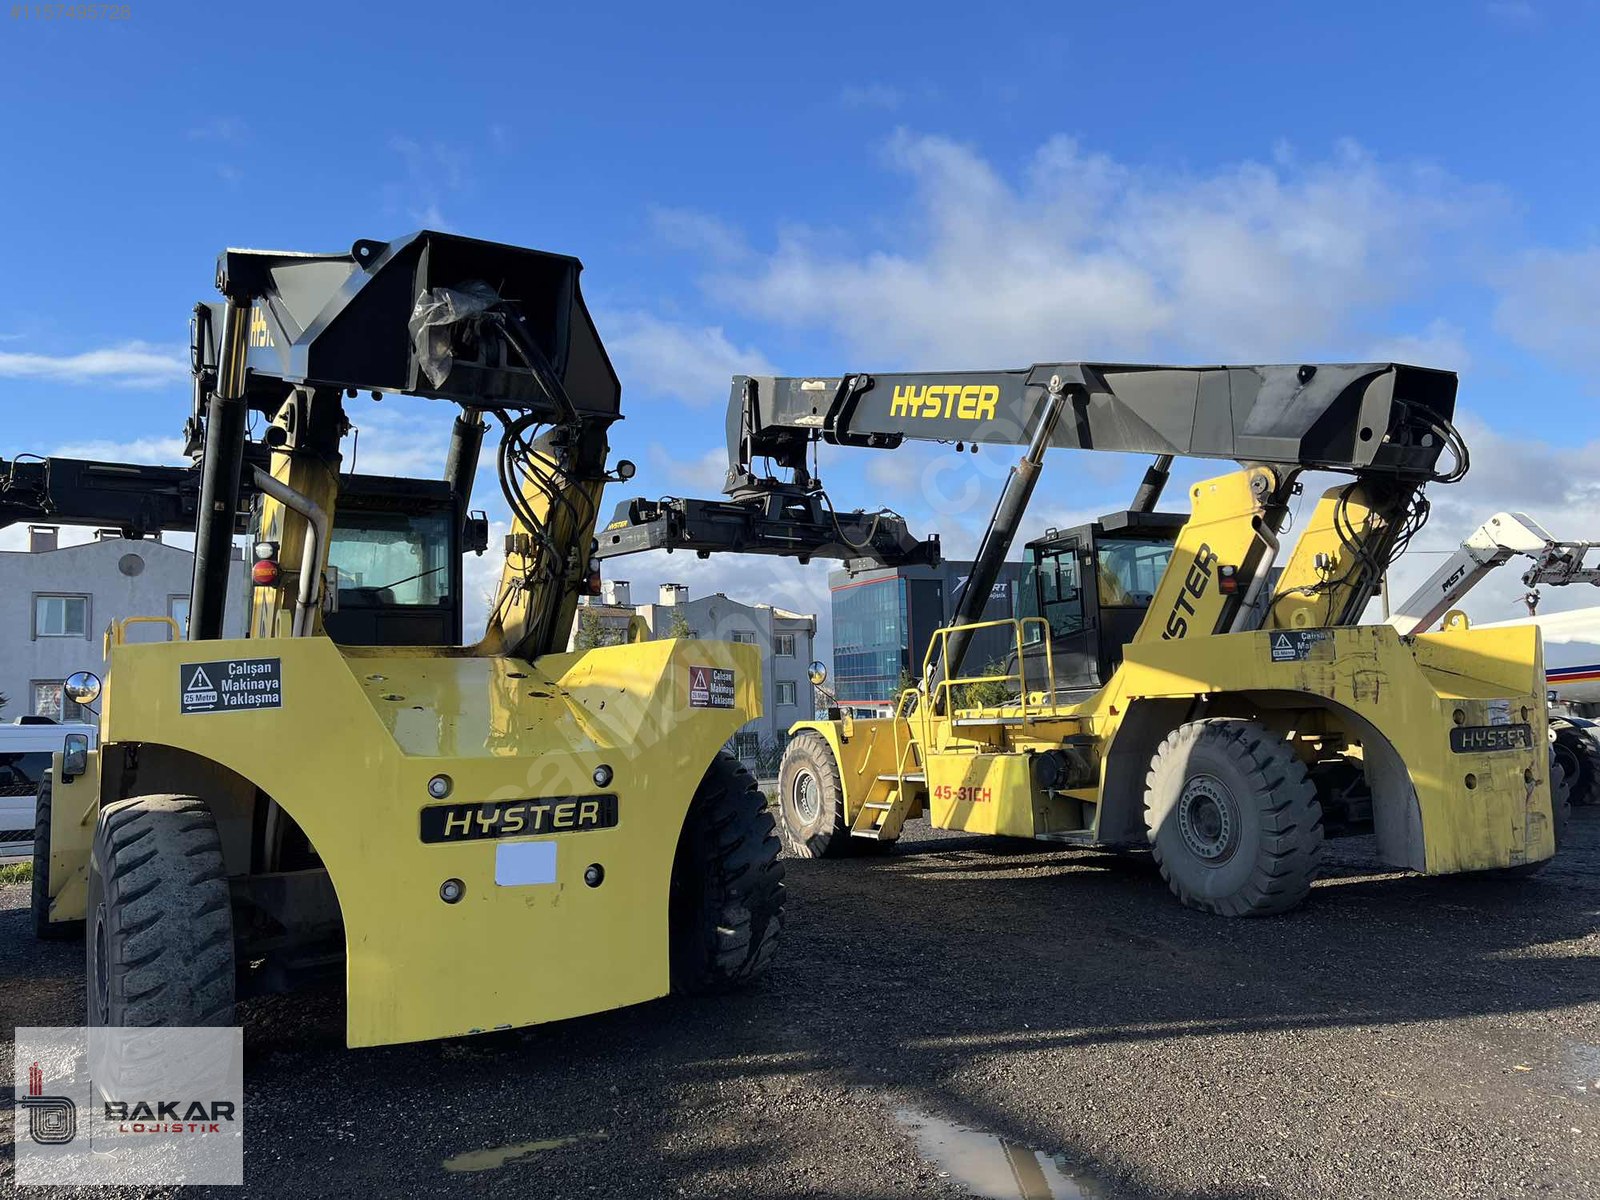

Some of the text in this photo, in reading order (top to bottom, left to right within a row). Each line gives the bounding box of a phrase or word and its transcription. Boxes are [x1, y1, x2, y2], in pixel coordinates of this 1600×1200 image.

[889, 385, 1000, 420] HYSTER
[1161, 542, 1218, 640] STER
[1441, 564, 1466, 592] MST
[228, 662, 271, 678] Çalışan
[221, 678, 279, 692] Makinaya
[222, 692, 279, 707] Yaklaşma
[444, 801, 600, 837] HYSTER
